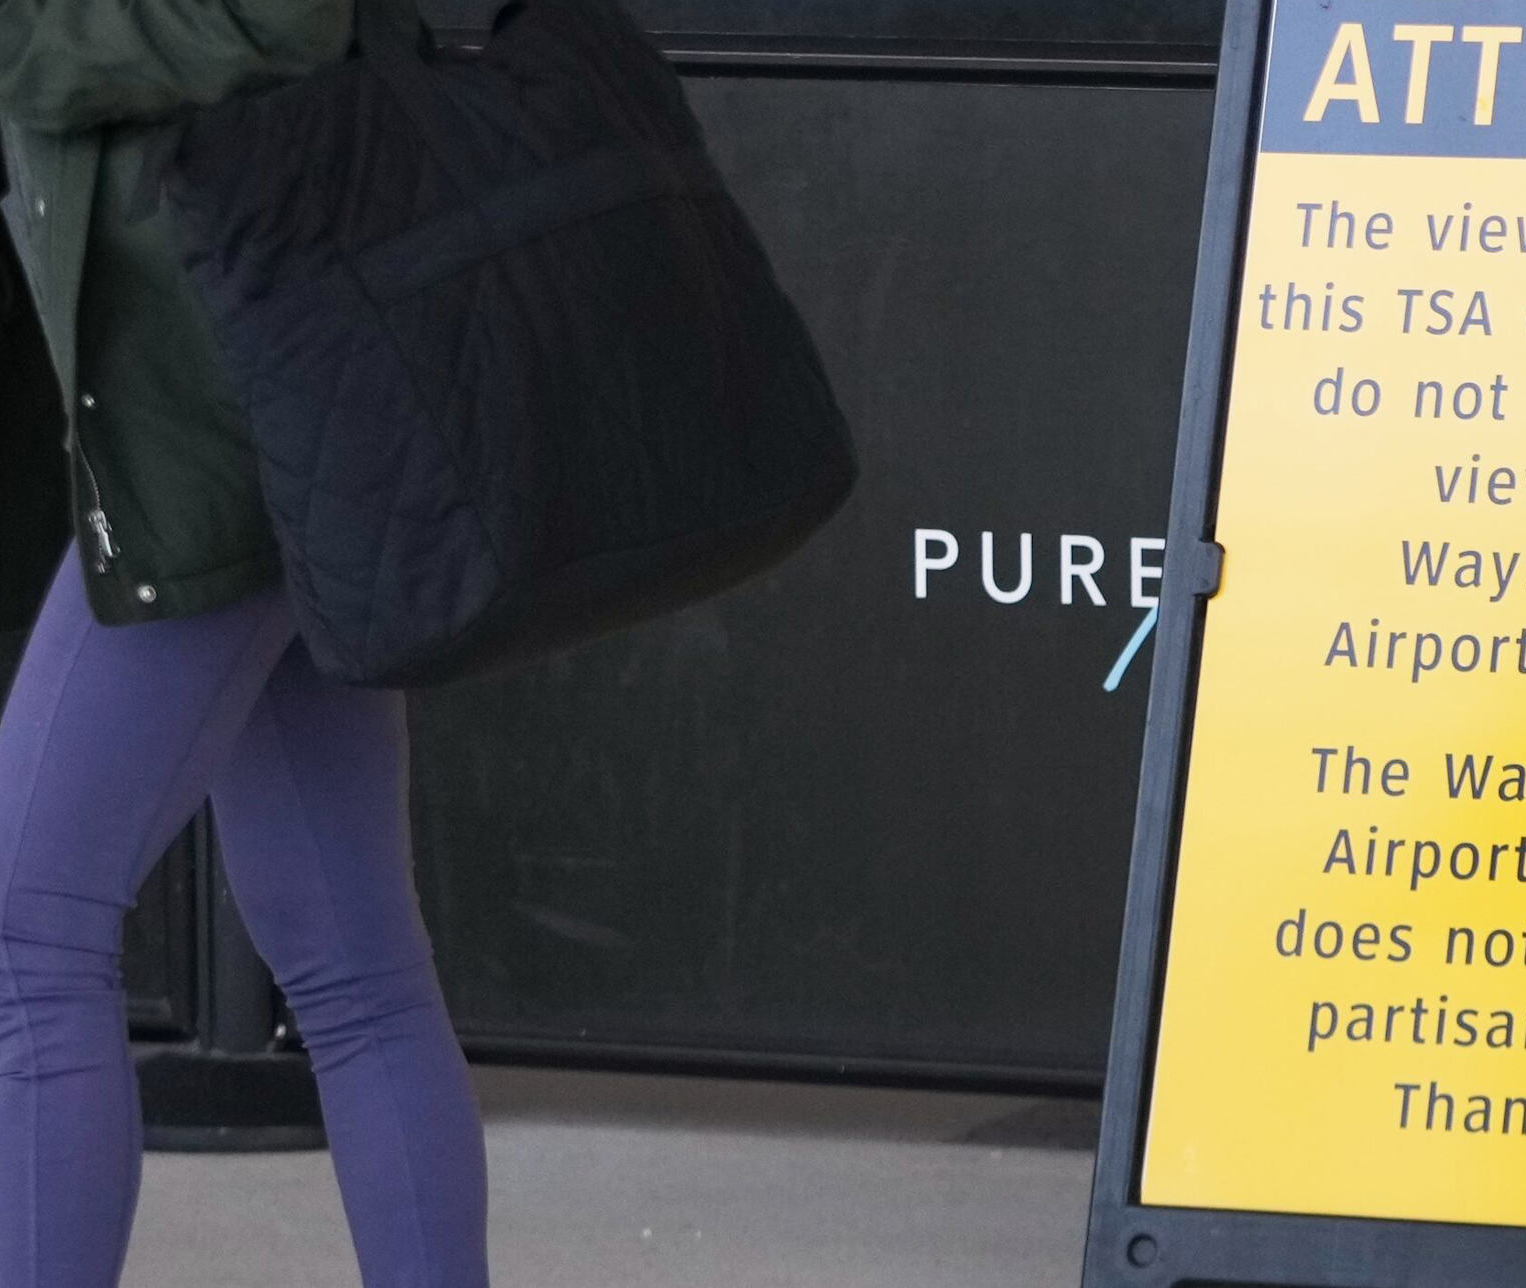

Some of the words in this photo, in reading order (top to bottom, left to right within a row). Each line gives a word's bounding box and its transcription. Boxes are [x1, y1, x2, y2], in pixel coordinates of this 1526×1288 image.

[1296, 199, 1393, 250] The
[1258, 281, 1364, 333] this
[1397, 288, 1492, 336] TSA
[1313, 367, 1381, 417] do
[1414, 374, 1508, 421] not
[915, 528, 1165, 608] PURE
[1311, 745, 1410, 797] The
[1276, 908, 1413, 963] does
